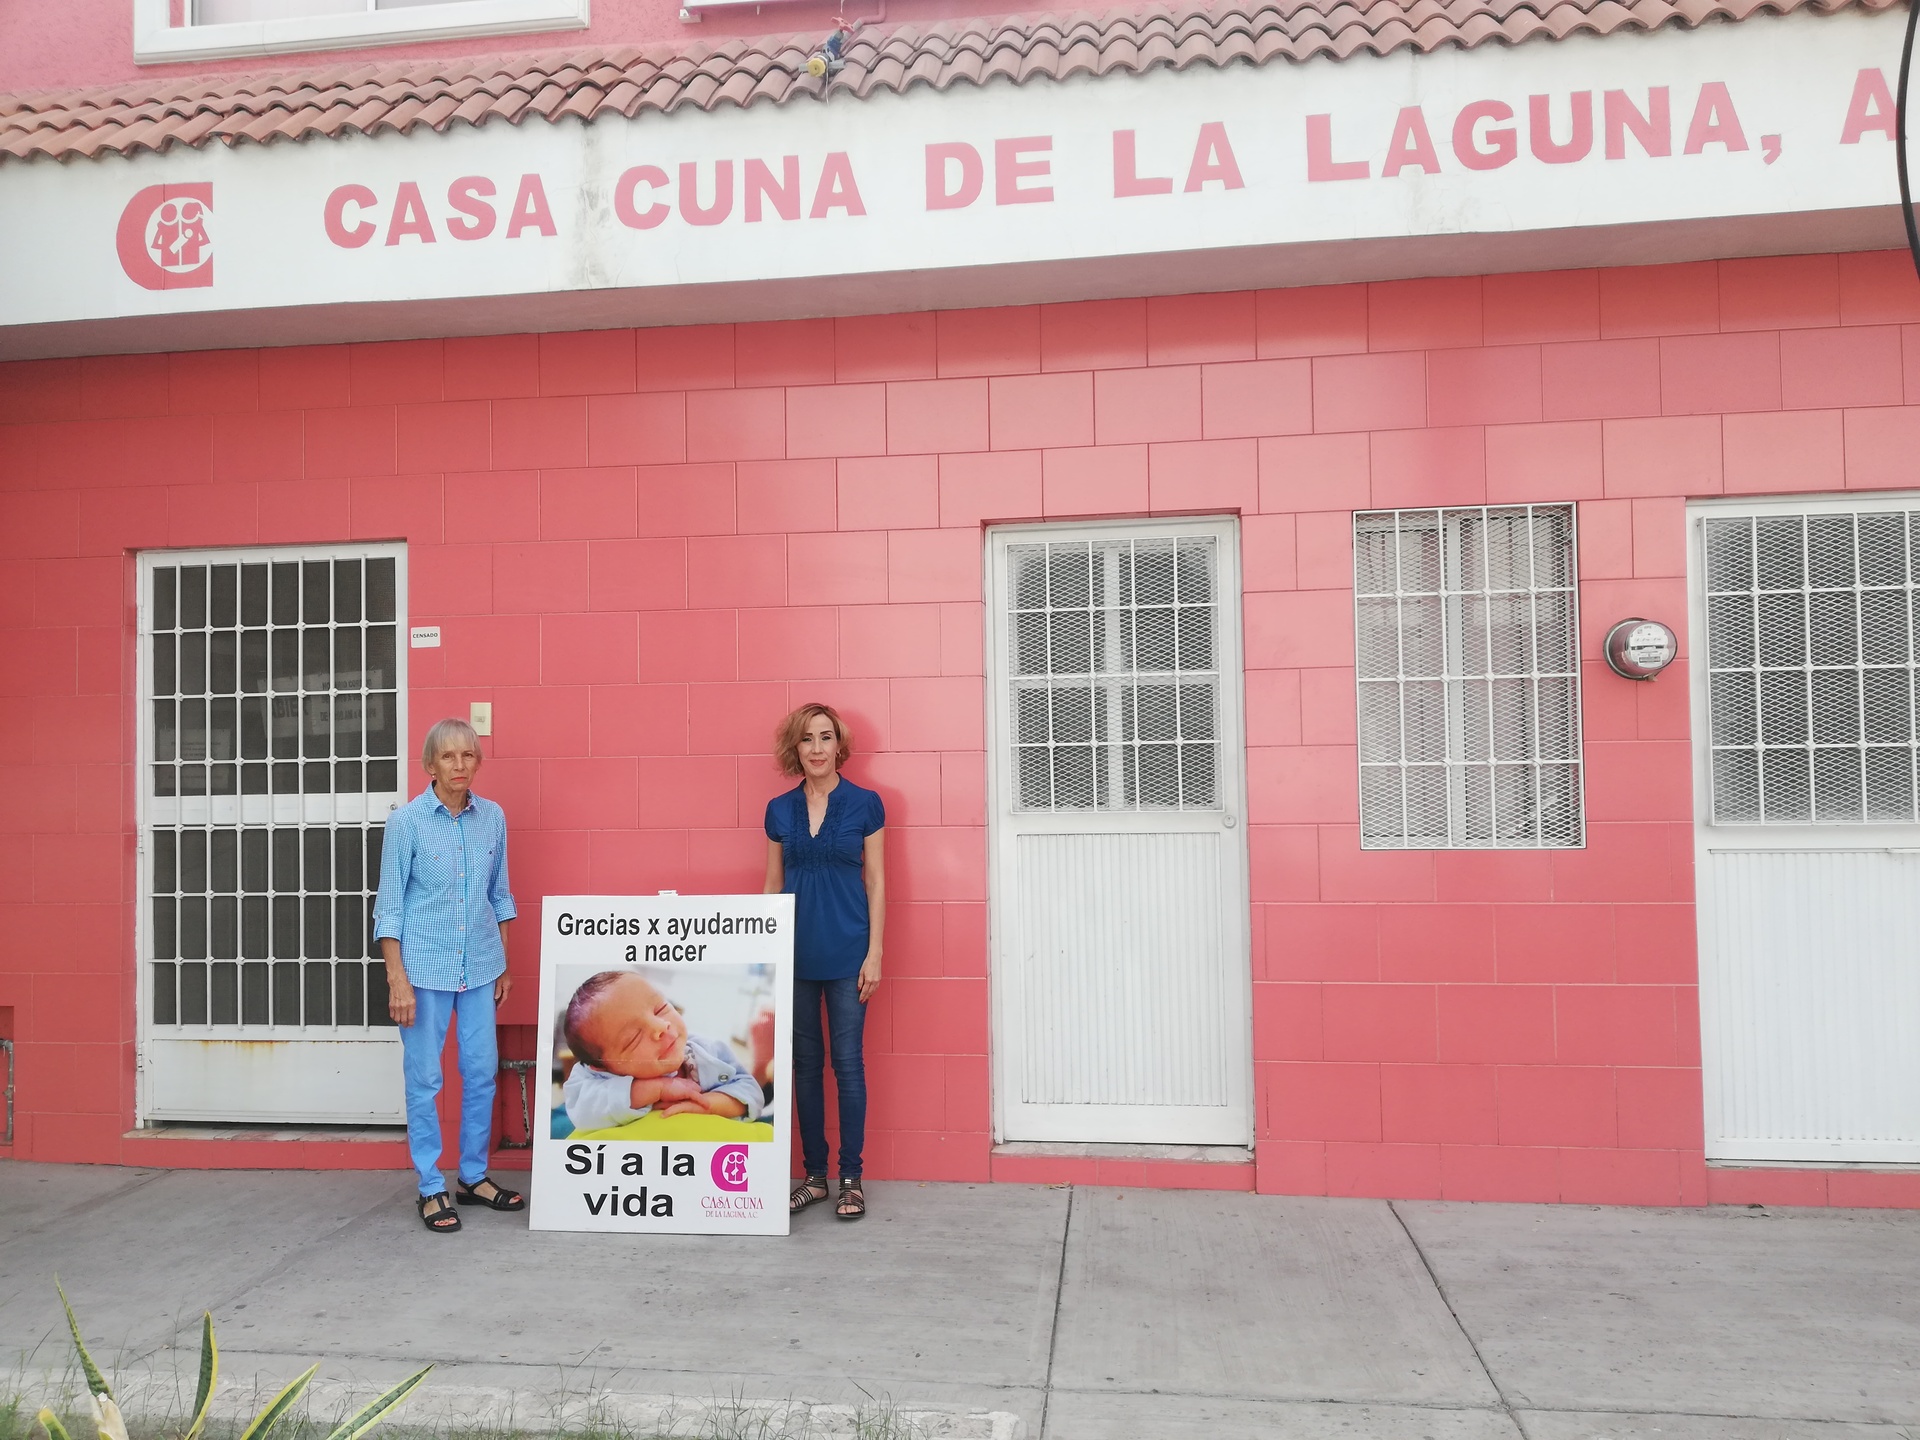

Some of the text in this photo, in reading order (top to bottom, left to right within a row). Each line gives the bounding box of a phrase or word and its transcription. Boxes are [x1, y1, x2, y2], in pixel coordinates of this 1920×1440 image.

[323, 173, 557, 249] CASA
[614, 152, 867, 231] CUNA
[925, 134, 1054, 211] DE
[1112, 121, 1245, 198] LA
[1305, 80, 1781, 183] LAGUNA,
[557, 911, 778, 941] Gracias x ayudarme
[625, 944, 707, 962] a nacer
[564, 1143, 696, 1177] Sí a la
[583, 1185, 674, 1218] vida
[701, 1196, 764, 1209] CASA CUNA
[705, 1210, 714, 1218] DE
[715, 1210, 722, 1218] LA
